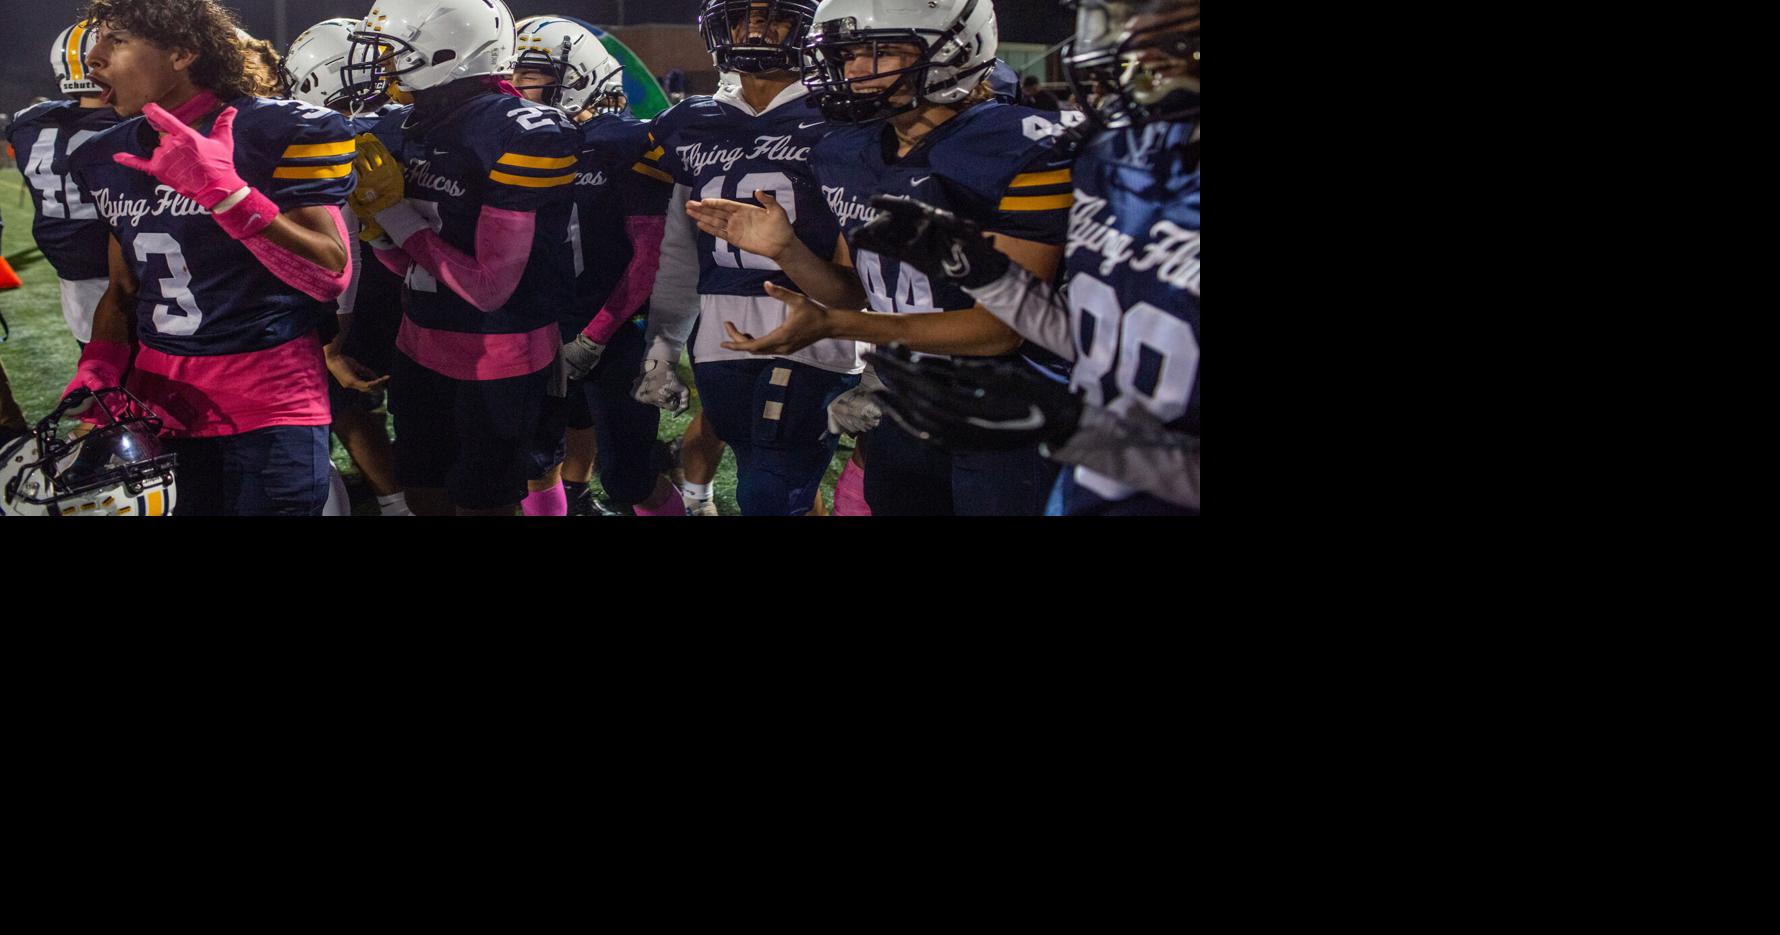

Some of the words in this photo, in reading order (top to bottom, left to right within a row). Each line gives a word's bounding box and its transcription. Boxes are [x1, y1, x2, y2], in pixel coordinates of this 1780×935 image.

[404, 157, 466, 198] Flucos
[675, 142, 744, 176] Flying
[90, 187, 151, 227] Flying
[1064, 188, 1134, 277] Flying
[133, 232, 203, 336] 3
